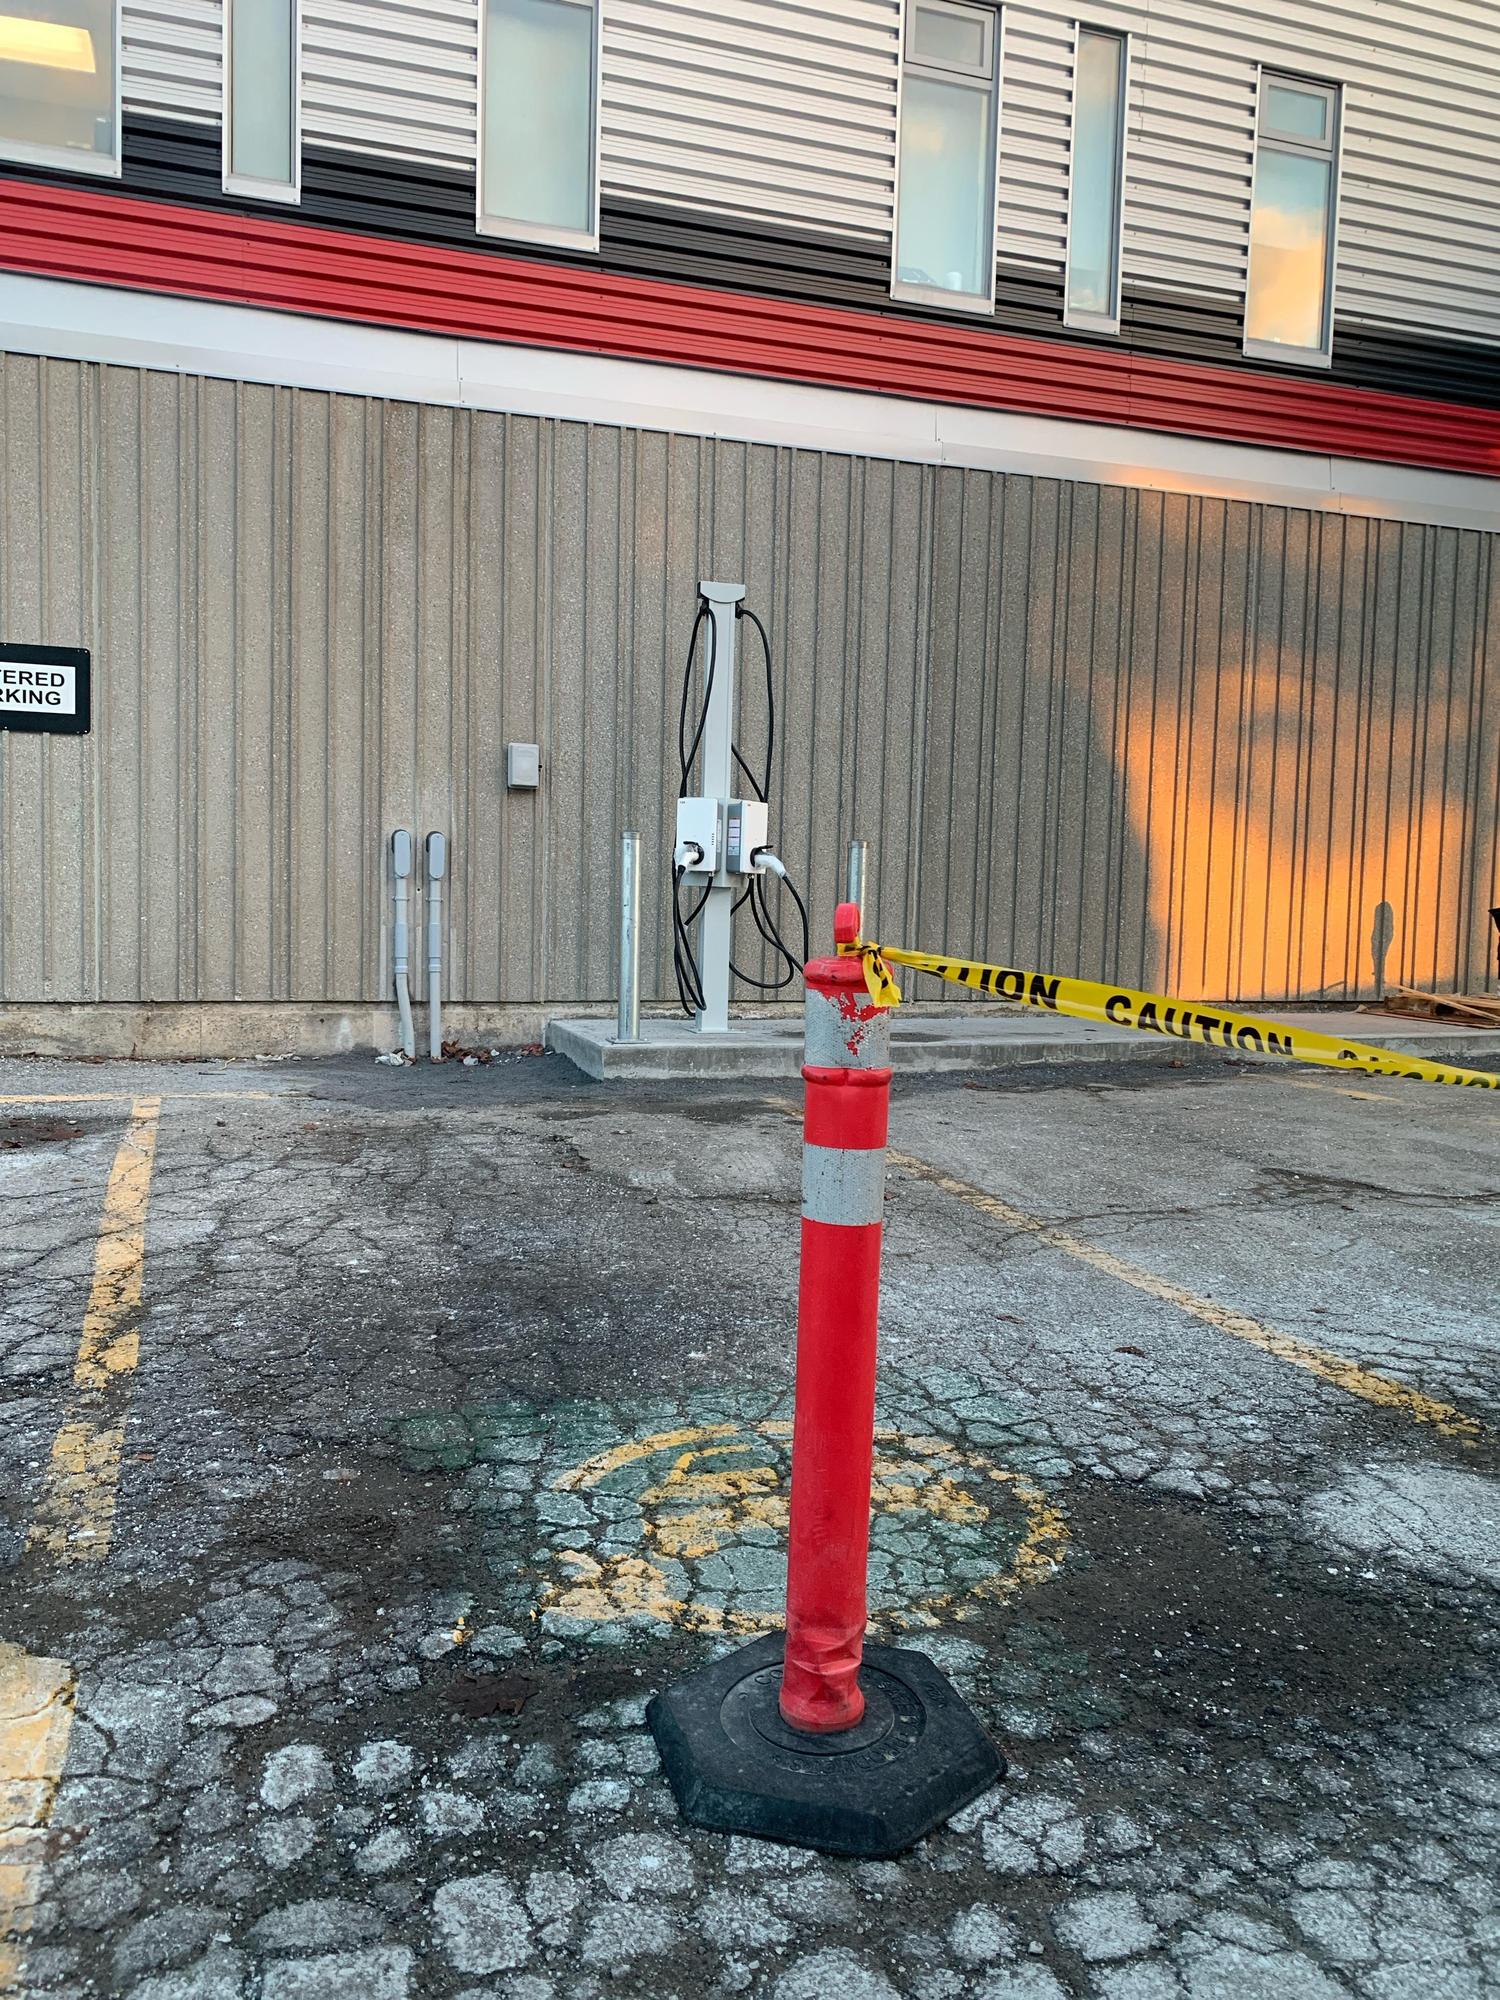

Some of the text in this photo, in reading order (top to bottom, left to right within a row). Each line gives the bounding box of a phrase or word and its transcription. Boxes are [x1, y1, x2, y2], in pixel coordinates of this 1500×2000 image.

[0, 669, 65, 687] ERED
[0, 688, 61, 706] KING
[1105, 994, 1294, 1056] CAUTION
